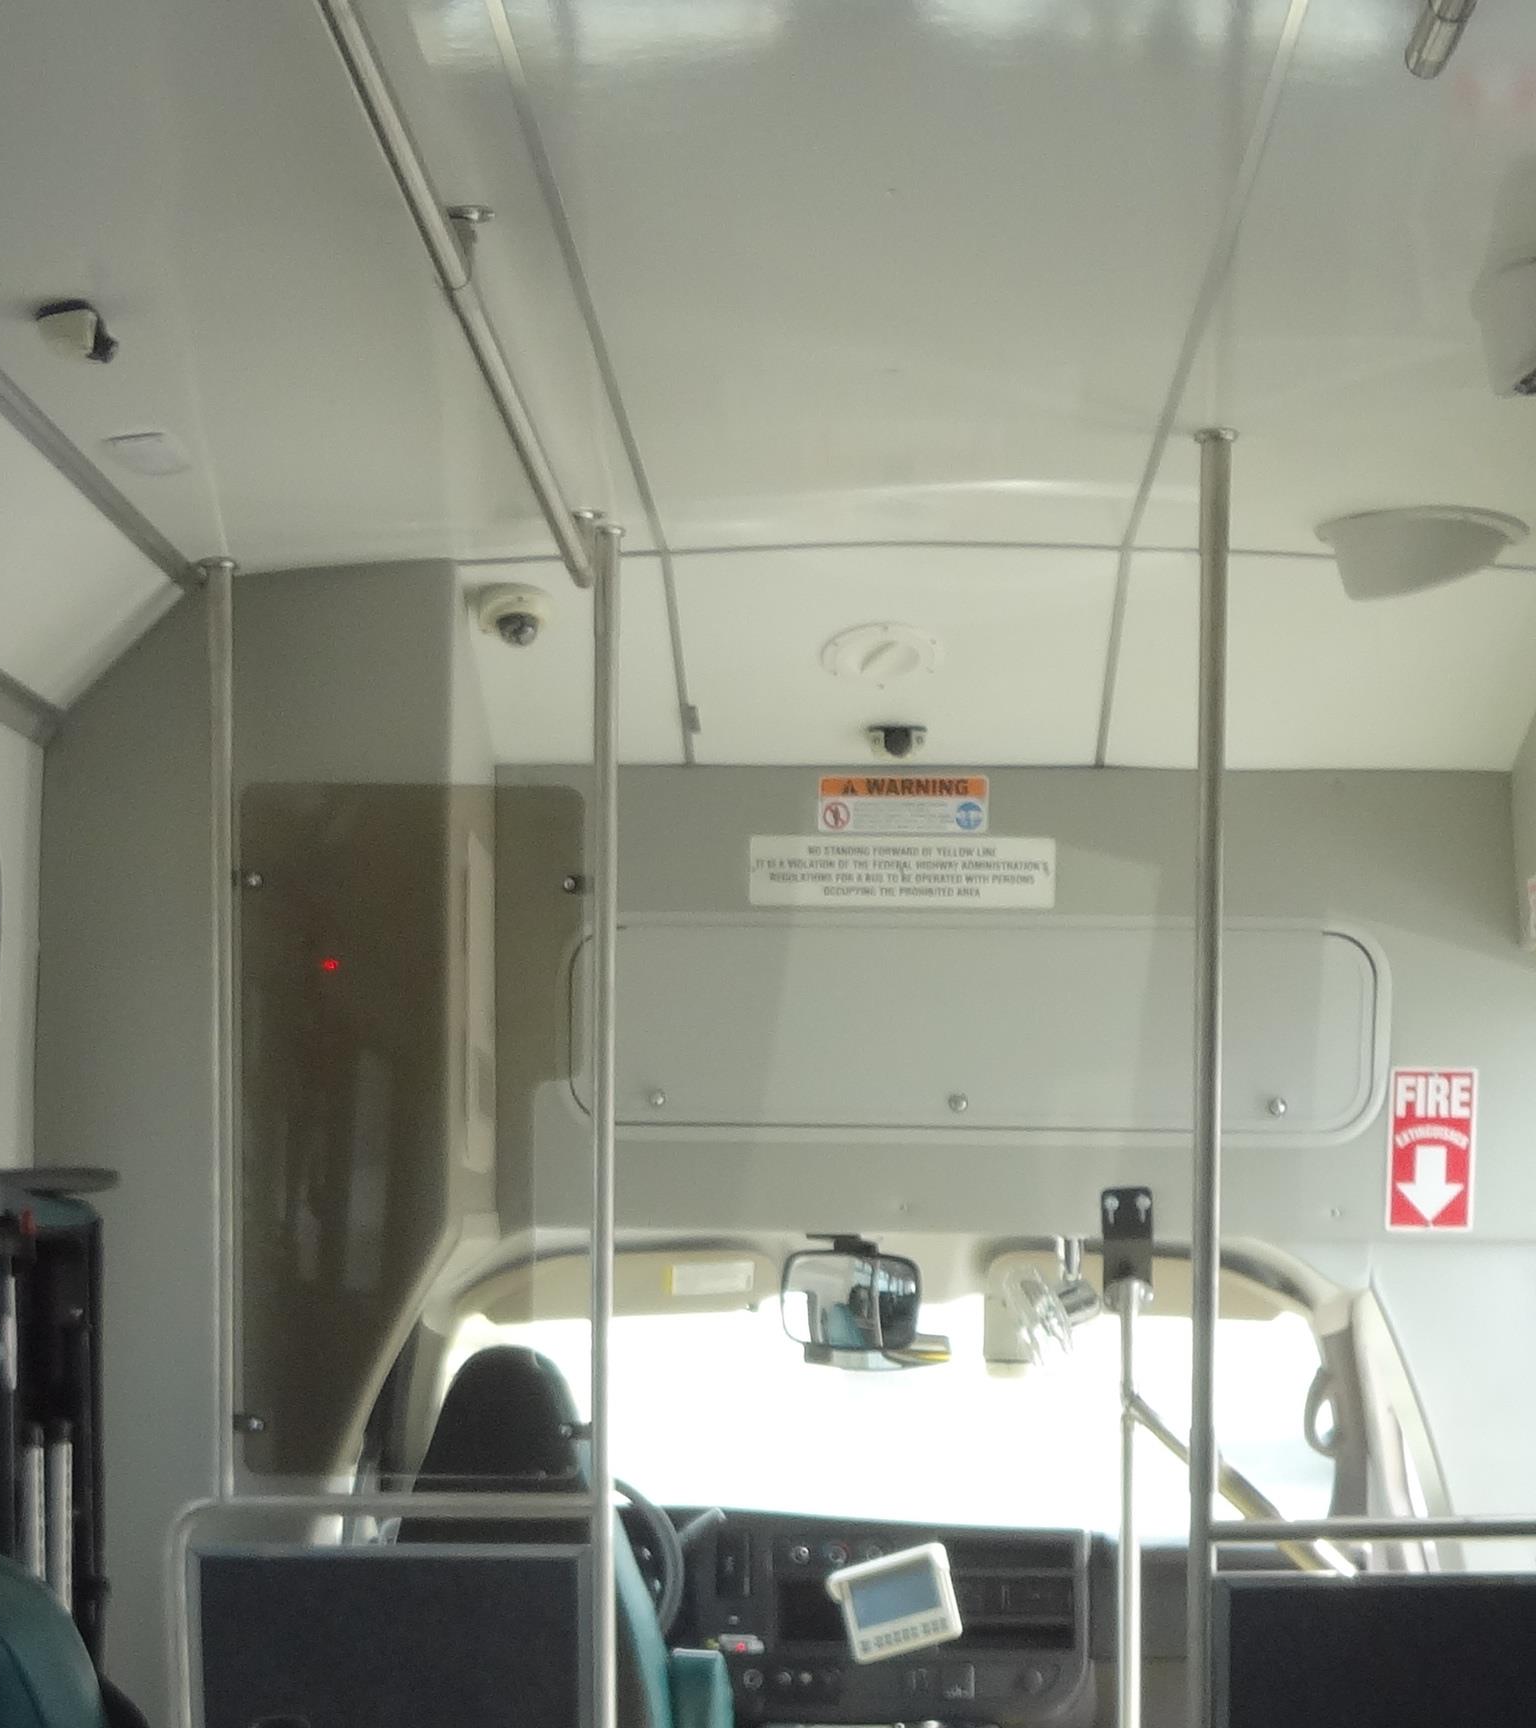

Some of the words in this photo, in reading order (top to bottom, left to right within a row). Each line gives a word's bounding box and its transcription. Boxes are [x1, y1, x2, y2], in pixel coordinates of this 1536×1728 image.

[866, 777, 969, 796] WARNING
[824, 846, 870, 857] STANDING
[873, 847, 919, 857] FORWARD
[937, 847, 974, 858] YELLOW
[976, 848, 997, 858] LINE
[872, 860, 912, 870] FEDERAL
[916, 861, 959, 871] HIGHWAY
[915, 874, 962, 884] OPERATED
[965, 875, 989, 885] WITH
[1395, 1074, 1472, 1118] FIRE
